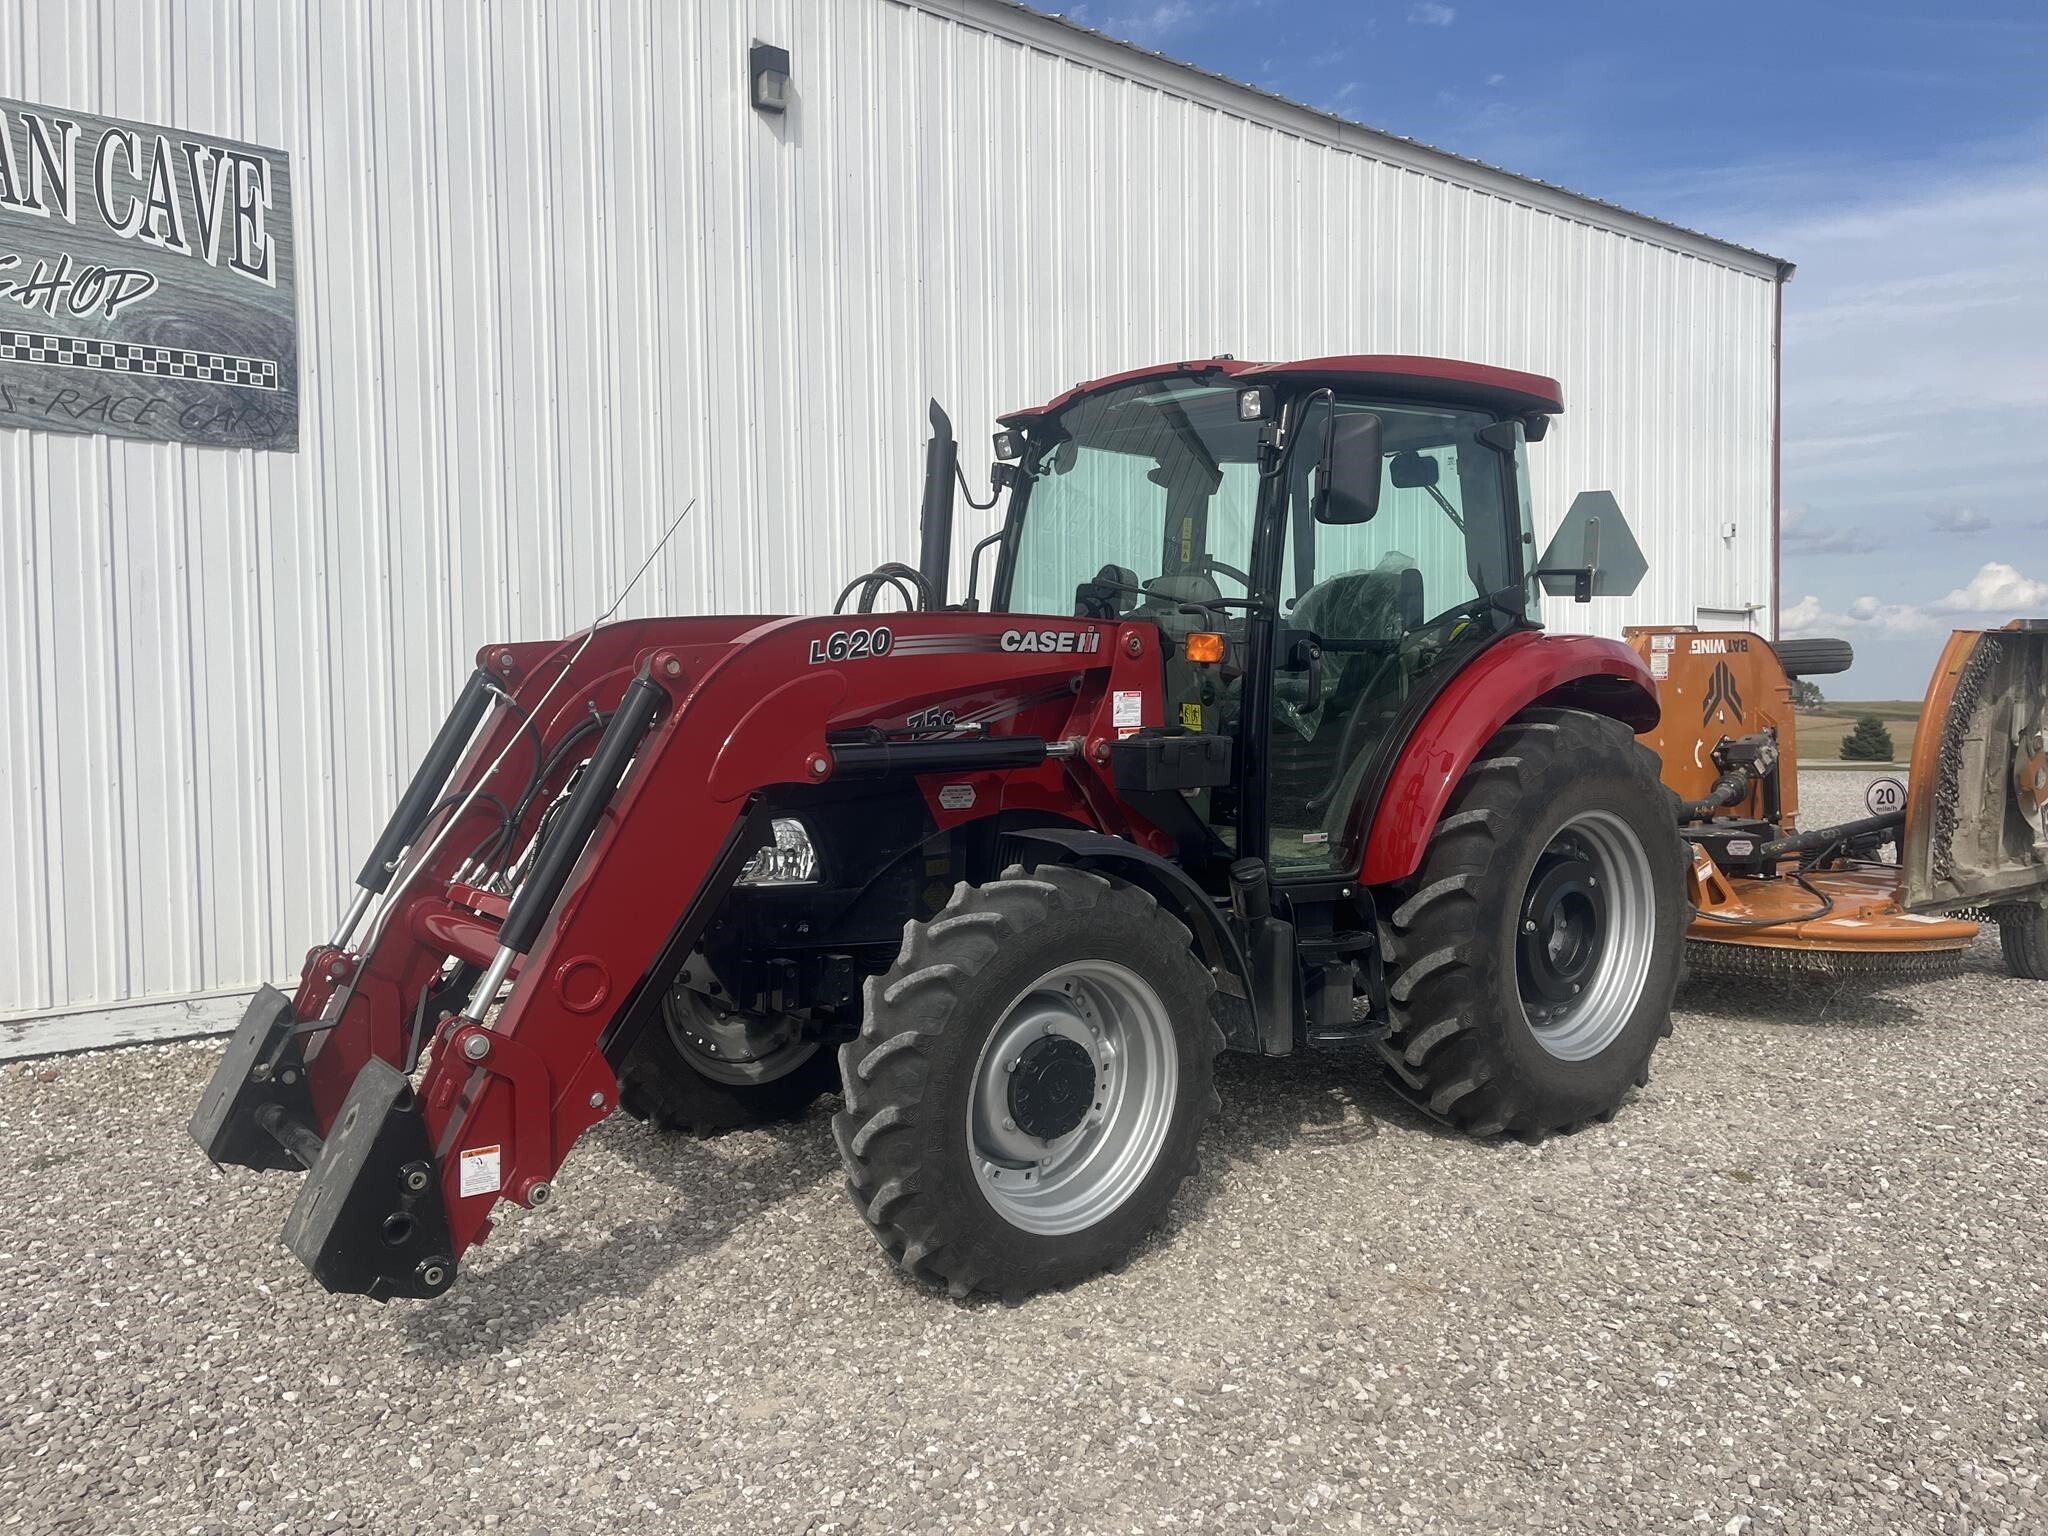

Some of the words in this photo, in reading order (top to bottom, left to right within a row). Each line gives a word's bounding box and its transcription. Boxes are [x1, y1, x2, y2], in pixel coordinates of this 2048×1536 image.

[93, 127, 276, 288] CAVE
[45, 389, 166, 425] RACE
[809, 627, 892, 664] L620
[1000, 630, 1075, 652] CASE
[1876, 788, 1895, 804] 20
